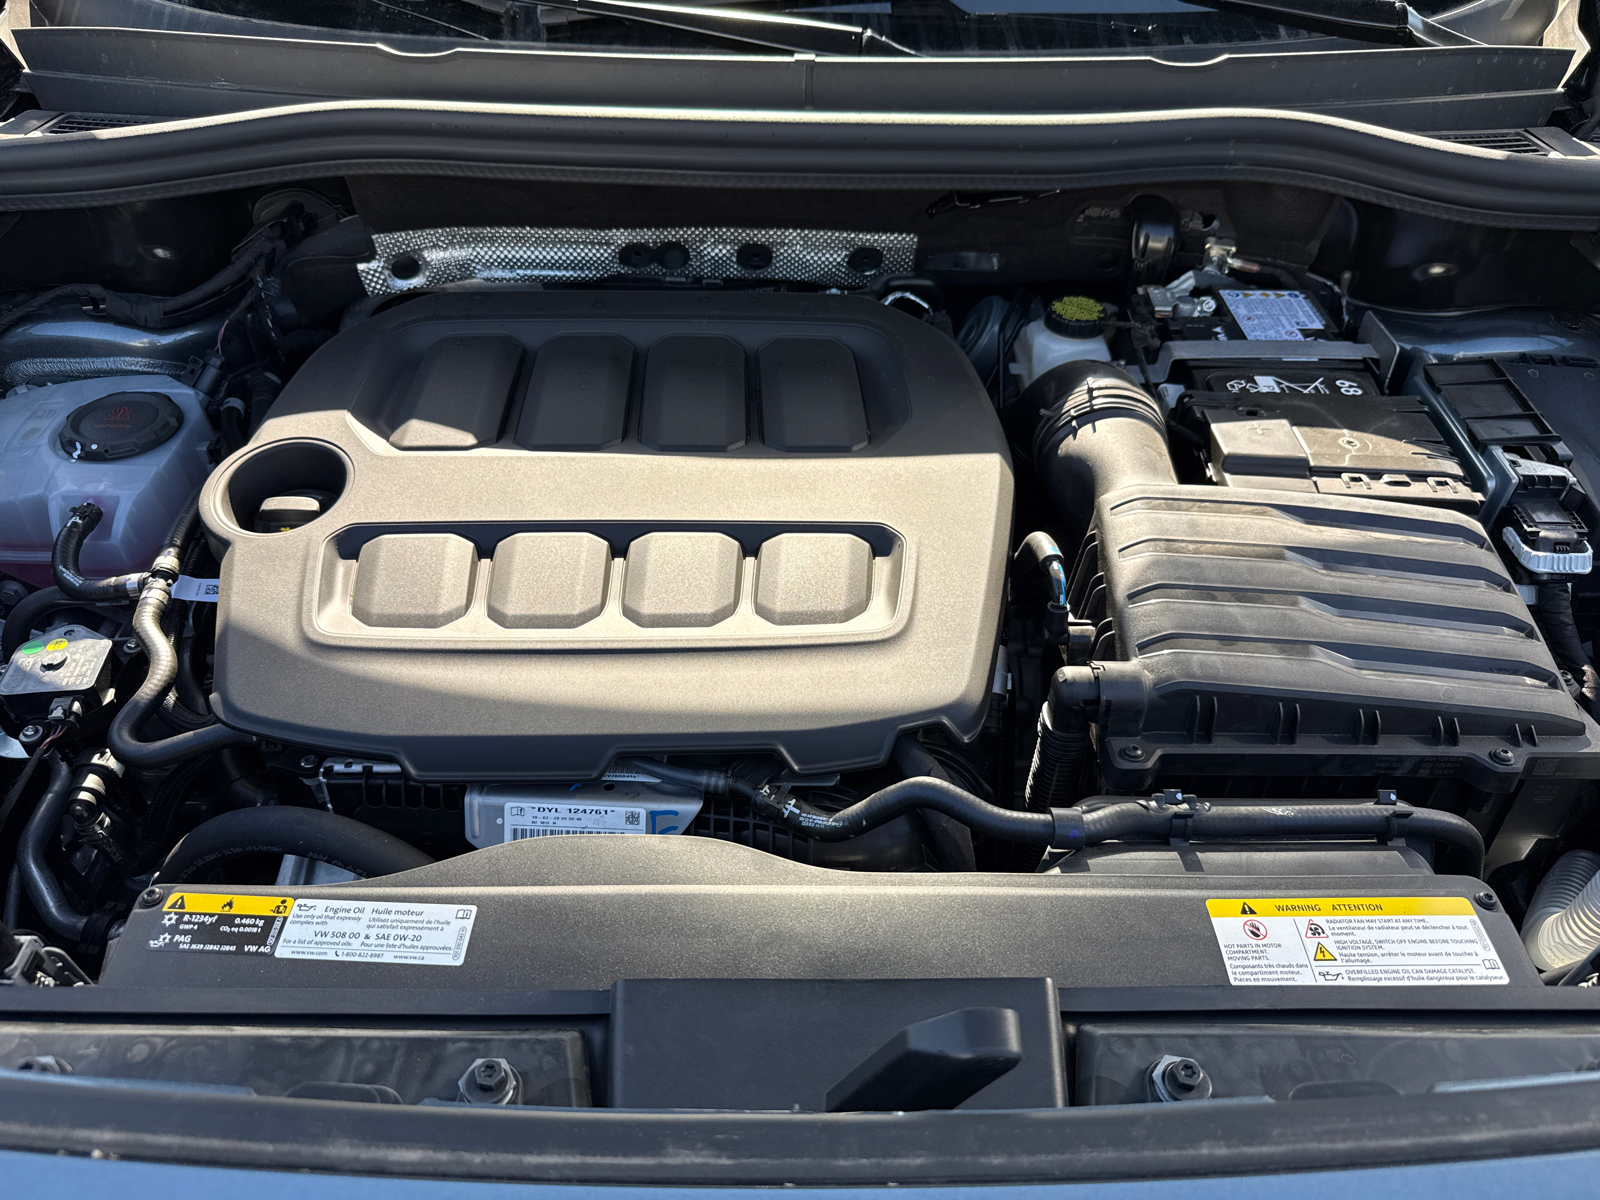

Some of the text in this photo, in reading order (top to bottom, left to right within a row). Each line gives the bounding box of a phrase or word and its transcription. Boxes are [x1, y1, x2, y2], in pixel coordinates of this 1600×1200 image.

[324, 906, 351, 914] Engine
[183, 914, 218, 925] R-1234yf
[255, 918, 265, 926] kg
